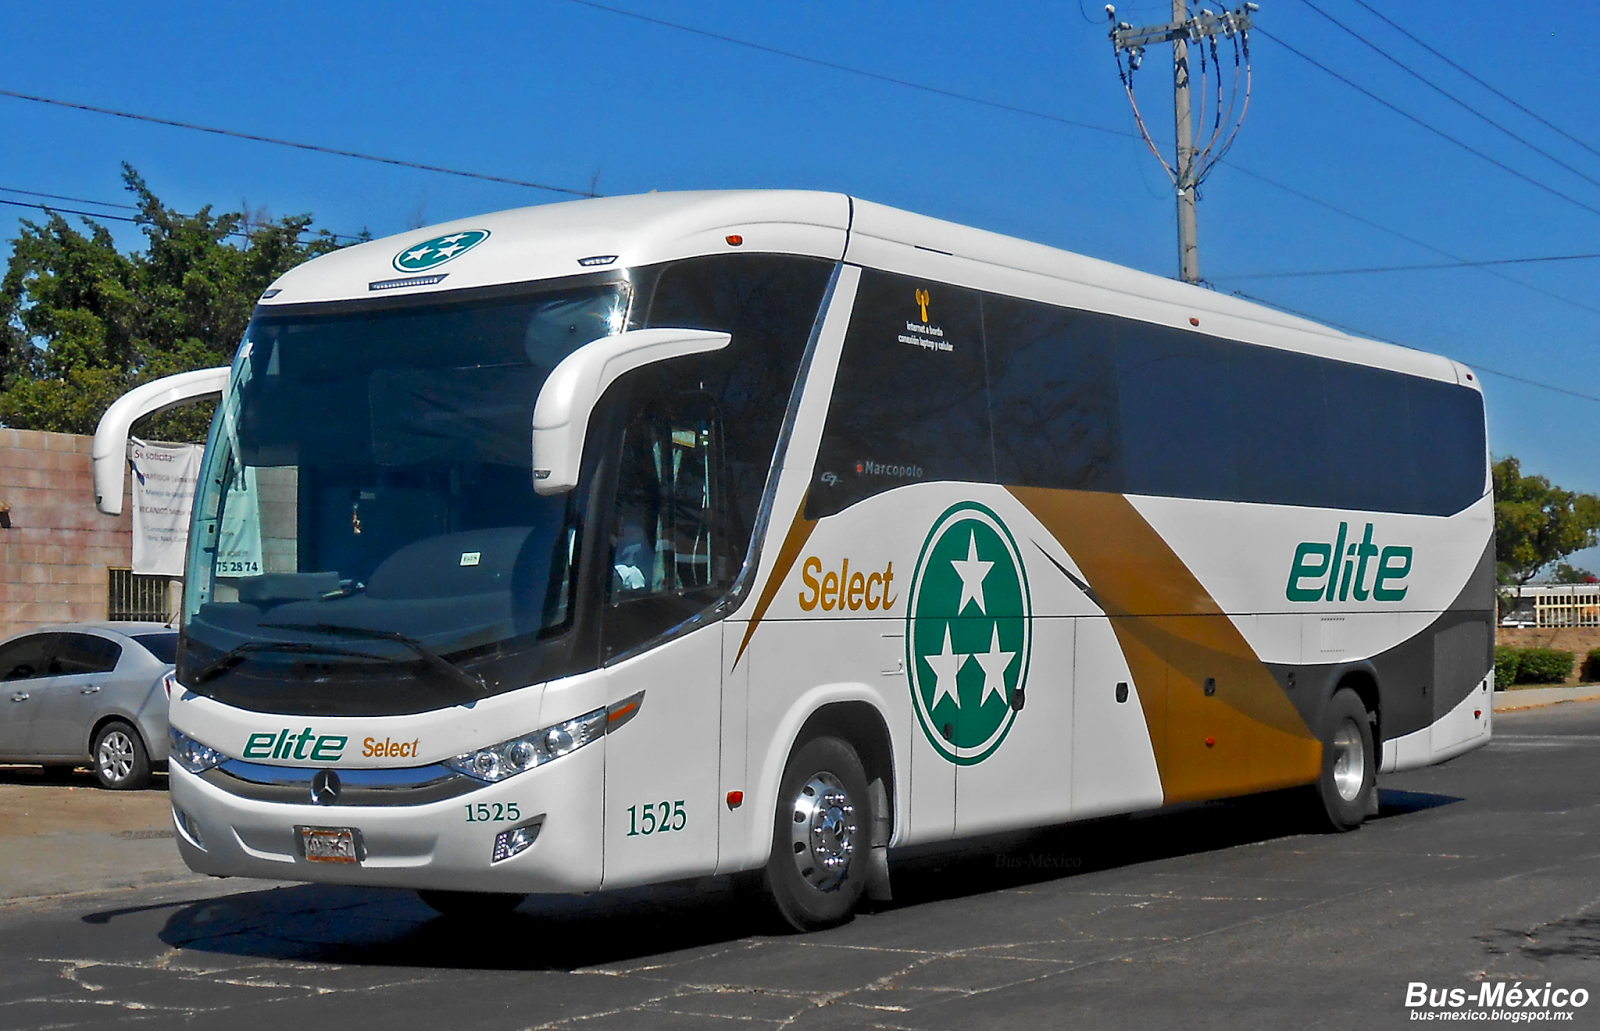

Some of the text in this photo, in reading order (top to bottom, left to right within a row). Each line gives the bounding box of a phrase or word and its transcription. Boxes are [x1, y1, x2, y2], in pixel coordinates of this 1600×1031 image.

[929, 325, 944, 337] bordo
[919, 336, 934, 351] laptop
[938, 341, 954, 352] celular
[865, 461, 923, 478] Marcopolo
[230, 561, 243, 572] 28
[245, 561, 258, 572] 74
[1286, 521, 1413, 602] elite
[799, 556, 898, 611] Select
[243, 728, 421, 761] elite Select
[465, 802, 521, 822] 1525
[627, 800, 687, 836] 1525
